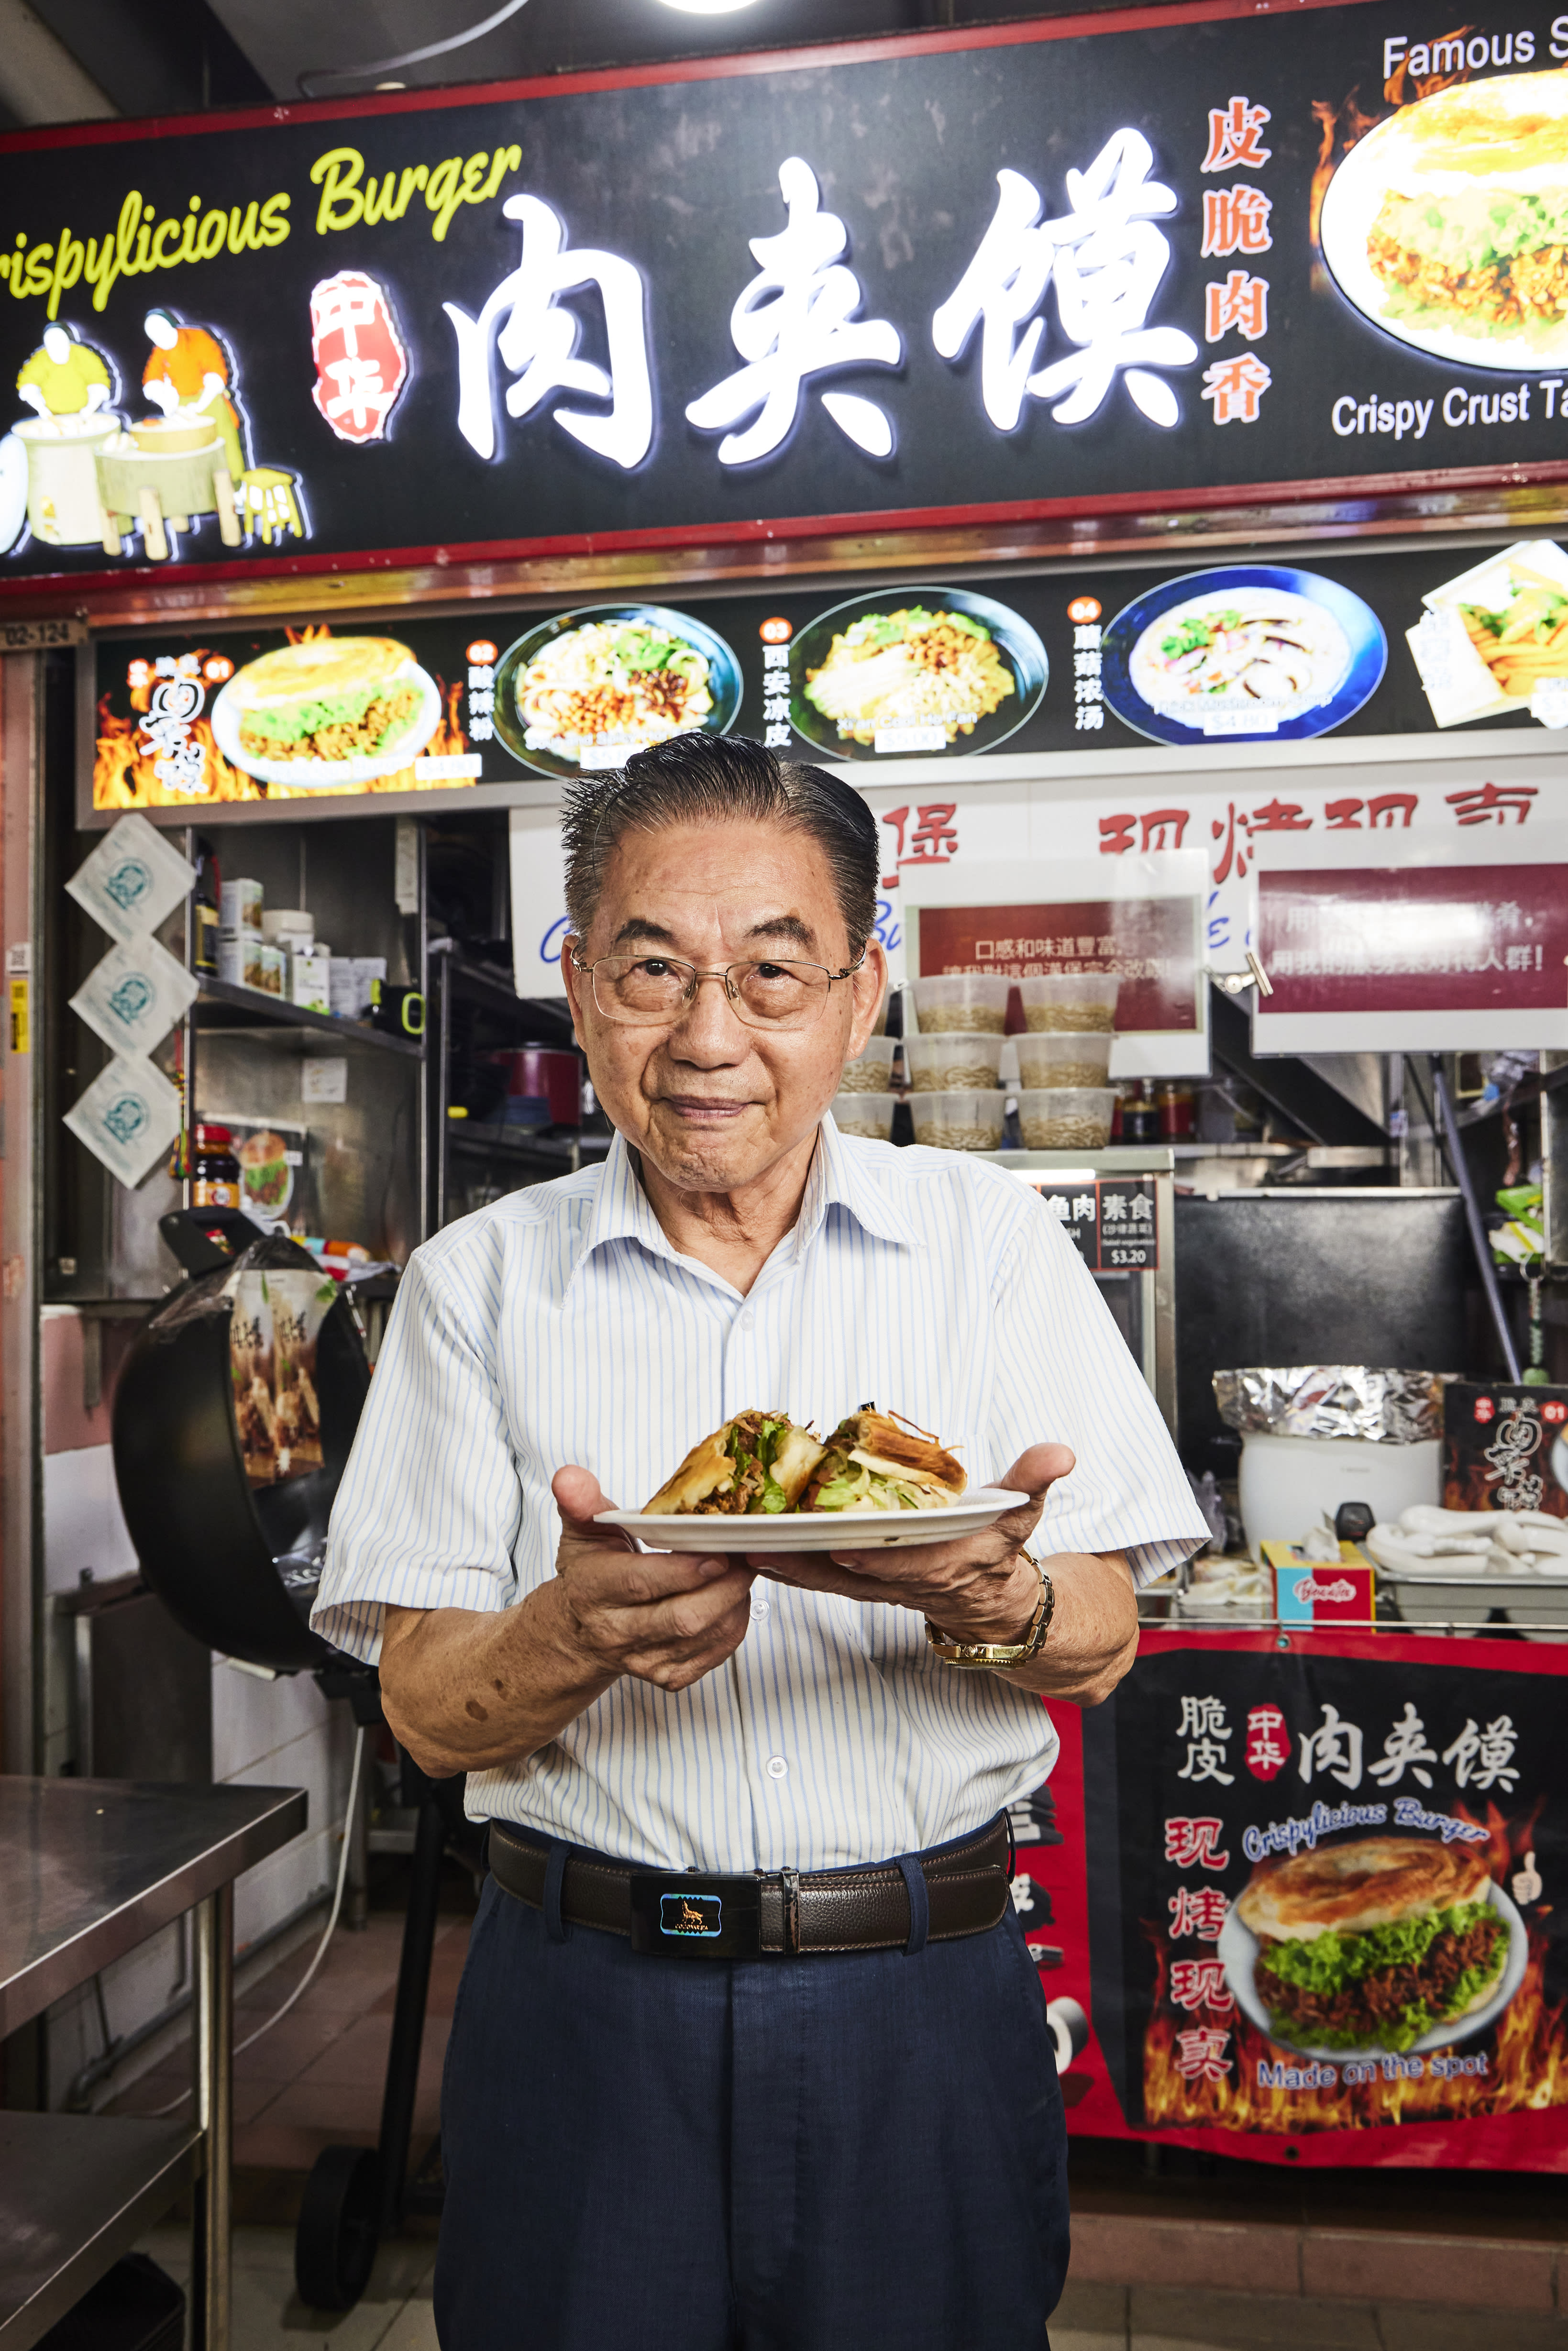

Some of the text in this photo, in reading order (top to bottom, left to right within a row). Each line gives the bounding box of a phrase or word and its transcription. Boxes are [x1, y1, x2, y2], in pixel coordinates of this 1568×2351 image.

[1383, 30, 1535, 79] Famous
[309, 144, 523, 242] Burger
[1201, 97, 1272, 425] 皮脆肉香
[433, 127, 1198, 470] 肉夹馍
[316, 286, 395, 429] 中华
[1332, 394, 1434, 440] Crispy
[1443, 383, 1531, 427] Crust
[764, 623, 789, 640] 03
[1072, 601, 1097, 620] 04
[206, 662, 229, 678] 01
[469, 644, 494, 661] 02
[762, 644, 792, 748] 西安凉皮
[1047, 1194, 1096, 1222] 鱼肉
[1102, 1193, 1154, 1221] 素食
[1111, 1249, 1146, 1264] $3.20
[1545, 1405, 1565, 1420] 01
[1176, 1696, 1235, 1786] 脆皮
[1247, 1711, 1285, 1770] 中华
[1298, 1702, 1520, 1793] 肉夹馍
[1243, 1798, 1491, 1862] Crispylicious Burger
[1164, 1817, 1235, 2083] 现烤现卖
[1257, 2051, 1488, 2090] Made on the spot
